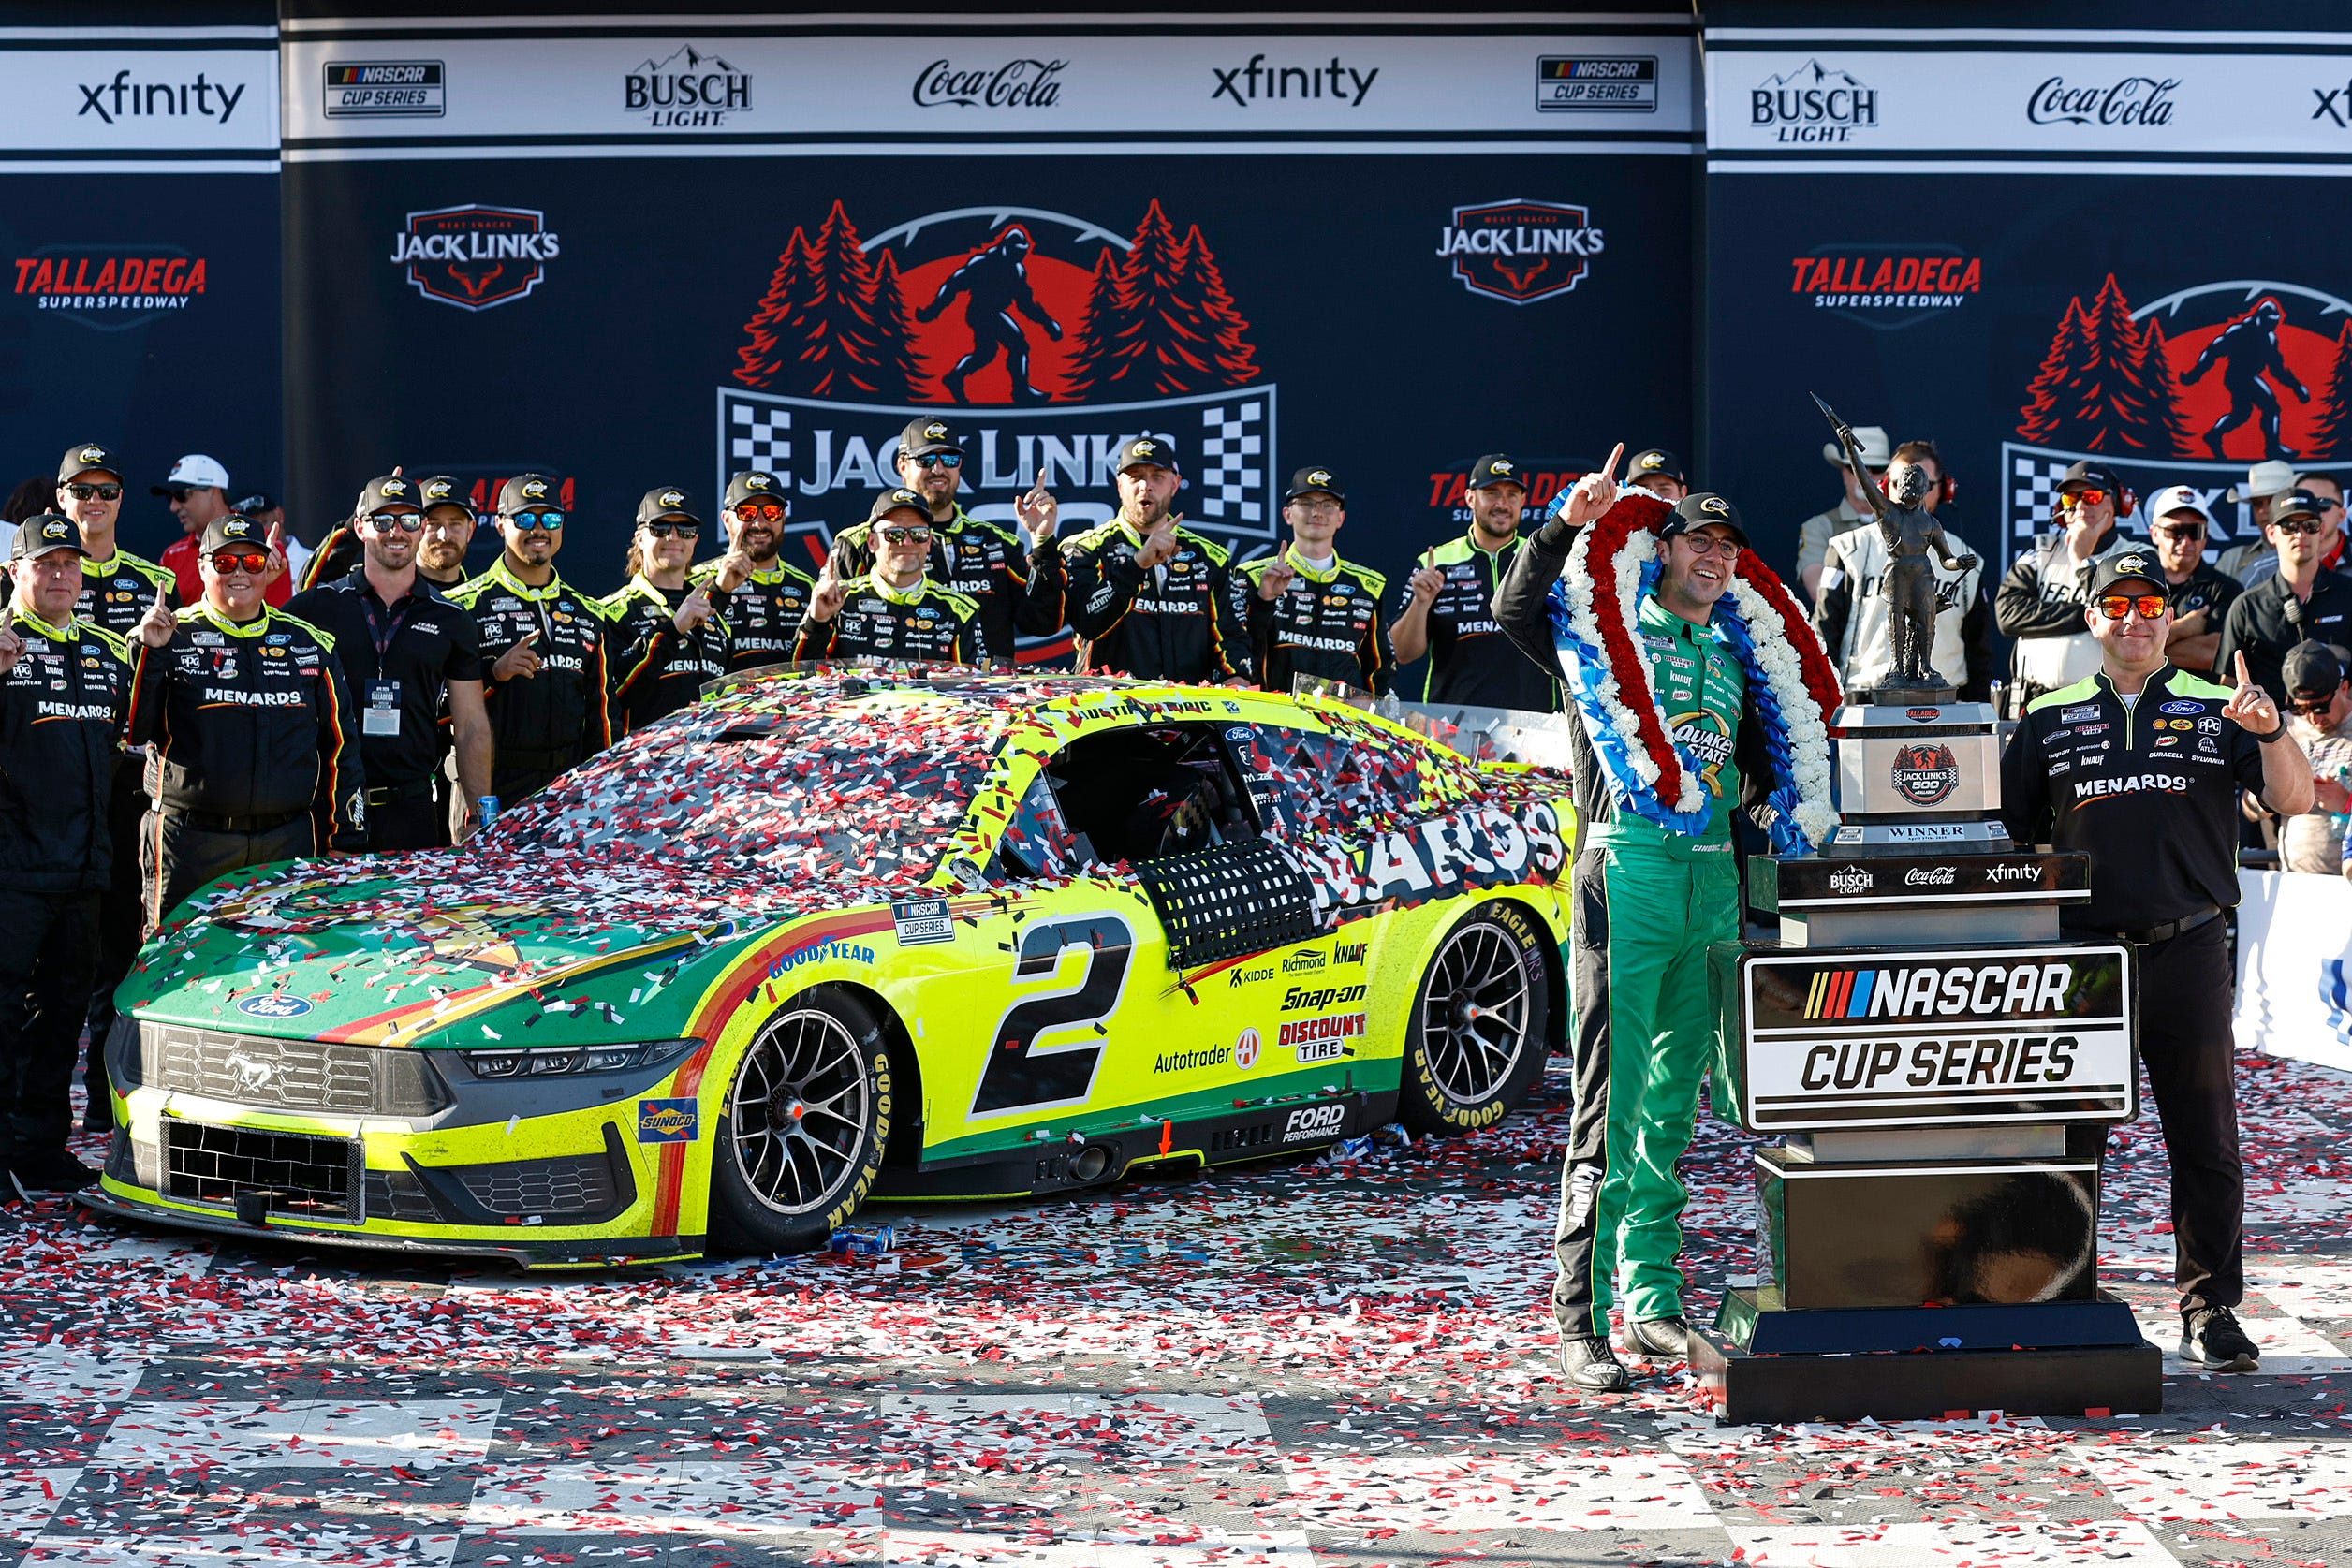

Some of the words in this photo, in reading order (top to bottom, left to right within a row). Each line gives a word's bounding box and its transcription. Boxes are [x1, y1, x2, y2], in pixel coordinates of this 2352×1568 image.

[361, 66, 426, 82] NASCAR
[1575, 62, 1640, 78] NASCAR
[912, 58, 1070, 108] Coca-Cola
[1212, 53, 1379, 107] xfinity
[78, 70, 245, 124] xfinity
[341, 90, 371, 106] CUP
[374, 88, 427, 105] SERIES
[625, 74, 752, 111] BUSCH
[1553, 84, 1584, 100] CUP
[1588, 82, 1640, 99] SERIES
[1751, 88, 1878, 126] BUSCH
[2026, 77, 2183, 126] Coca-Cola
[652, 111, 723, 127] LIGHT
[1778, 127, 1850, 142] LIGHT
[390, 232, 470, 263] JACK
[470, 228, 561, 260] LINK'S
[1435, 227, 1514, 257] JACK
[1515, 226, 1604, 256] LINK'S
[13, 258, 207, 295] TALLADEGA
[1791, 256, 1981, 293] TALLADEGA
[38, 295, 190, 310] SUPERSPEEDWAY
[1815, 294, 1964, 307] SUPERSPEEDWAY
[1135, 598, 1198, 613] ENARDS
[735, 637, 794, 652] MENAR
[1278, 630, 1356, 652] MENARDS
[1669, 669, 1693, 688] KNAUF
[205, 688, 301, 706] MENARDS
[38, 700, 110, 719] MENARDS
[2199, 719, 2220, 733] PPG
[2081, 755, 2105, 766] KNAUF
[2191, 755, 2225, 766] SYLVANIA
[1902, 772, 1922, 782] JACK
[1922, 771, 1948, 780] LINK'S
[1912, 781, 1940, 790] 500
[2074, 774, 2186, 798] MENARDS
[1889, 827, 1963, 837] WINNER
[1830, 873, 1873, 888] BUSCH
[1904, 867, 1957, 886] Coca-Cola
[1986, 863, 2042, 883] xfinity
[910, 902, 940, 916] NASCAR
[904, 921, 919, 934] CUP
[919, 919, 945, 932] SERIES
[1490, 902, 1536, 948] EAGLE
[768, 938, 875, 981] GOODYEAR
[1282, 951, 1326, 973] Richmond
[1243, 968, 1274, 983] KIDDE
[1281, 985, 1367, 1011] Snap-on
[1869, 963, 2073, 1018] NASCAR
[965, 910, 1137, 1121] 2
[1279, 1013, 1367, 1047] DISCOUNT
[1154, 1044, 1231, 1074] Autotrader
[1301, 1041, 1338, 1060] TIRE
[1801, 1042, 1902, 1091] CUP
[1906, 1036, 2079, 1088] SERIES
[1415, 1048, 1504, 1127] GOODYEAR
[640, 1113, 698, 1129] SUNOCO
[1286, 1104, 1345, 1131] FORD
[826, 1053, 892, 1230] GOODYEAR
[1283, 1124, 1341, 1143] PERFORMANCE
[1568, 1163, 1602, 1228] KNAUF
